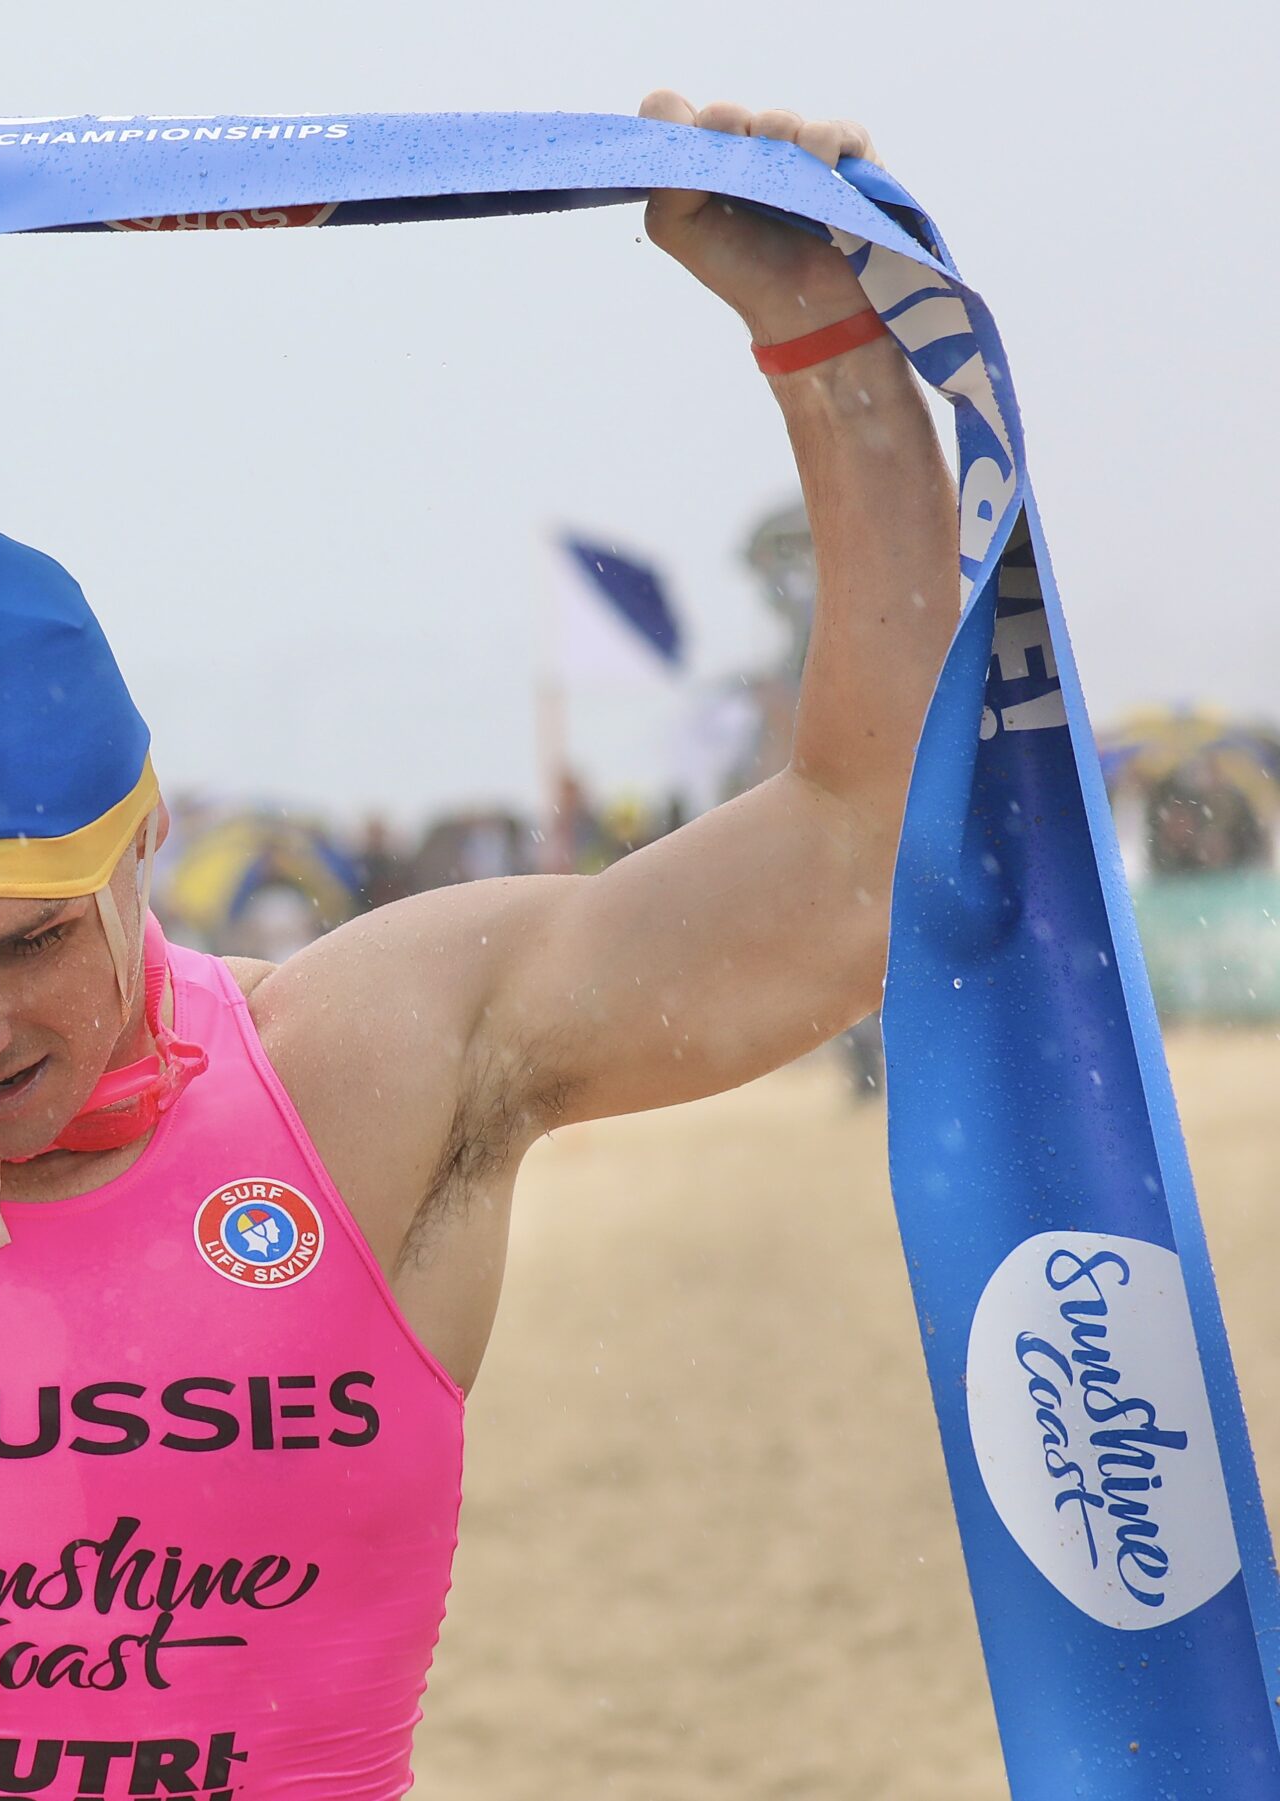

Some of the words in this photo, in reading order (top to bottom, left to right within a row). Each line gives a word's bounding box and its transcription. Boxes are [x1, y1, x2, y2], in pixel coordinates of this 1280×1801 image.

[205, 1240, 247, 1277] LIFE
[254, 1231, 317, 1282] SAVING
[220, 1183, 284, 1206] SURF
[1015, 1330, 1105, 1570] Coast
[1044, 1248, 1188, 1608] Sunshine
